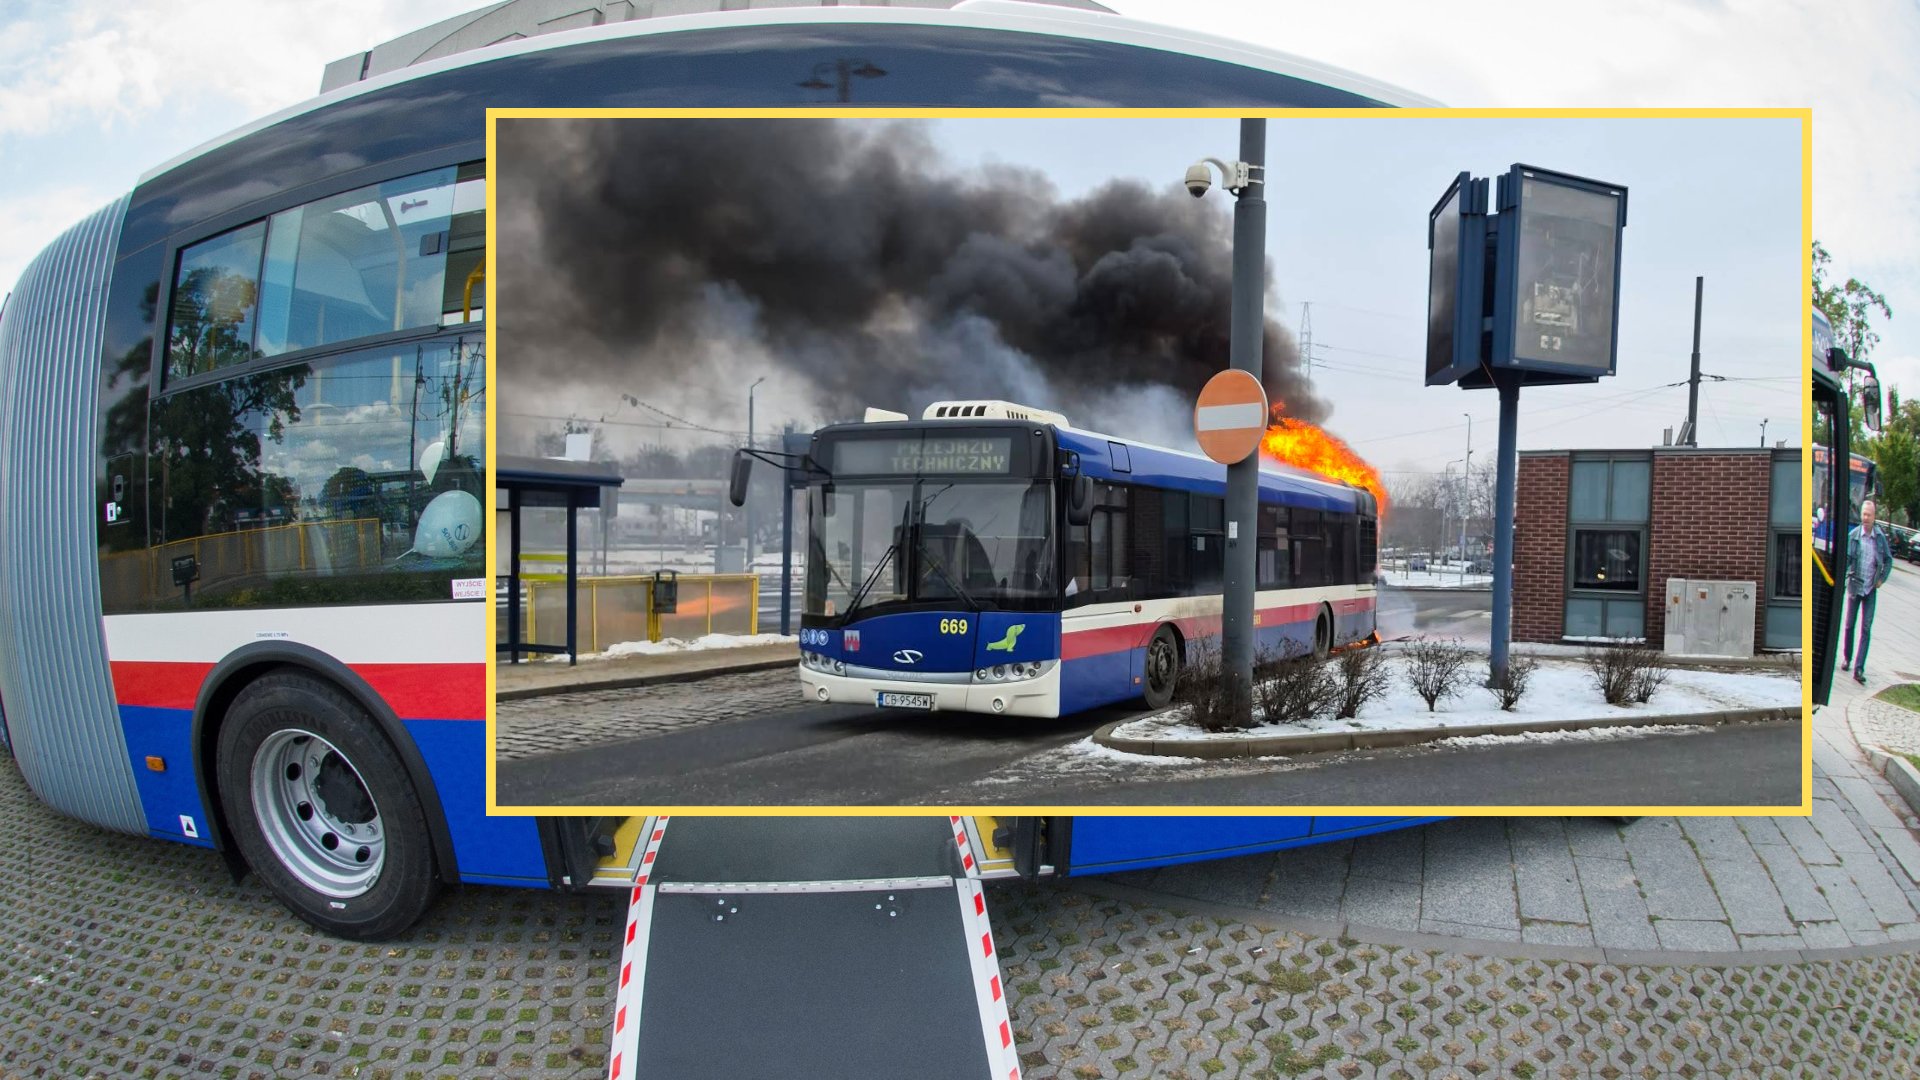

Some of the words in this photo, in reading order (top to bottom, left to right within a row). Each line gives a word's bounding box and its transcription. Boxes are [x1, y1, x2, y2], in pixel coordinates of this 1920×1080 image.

[897, 439, 993, 455] PRZEJAZD
[891, 455, 1005, 473] TECHNICZNY
[940, 618, 968, 634] 669
[885, 694, 897, 705] CB
